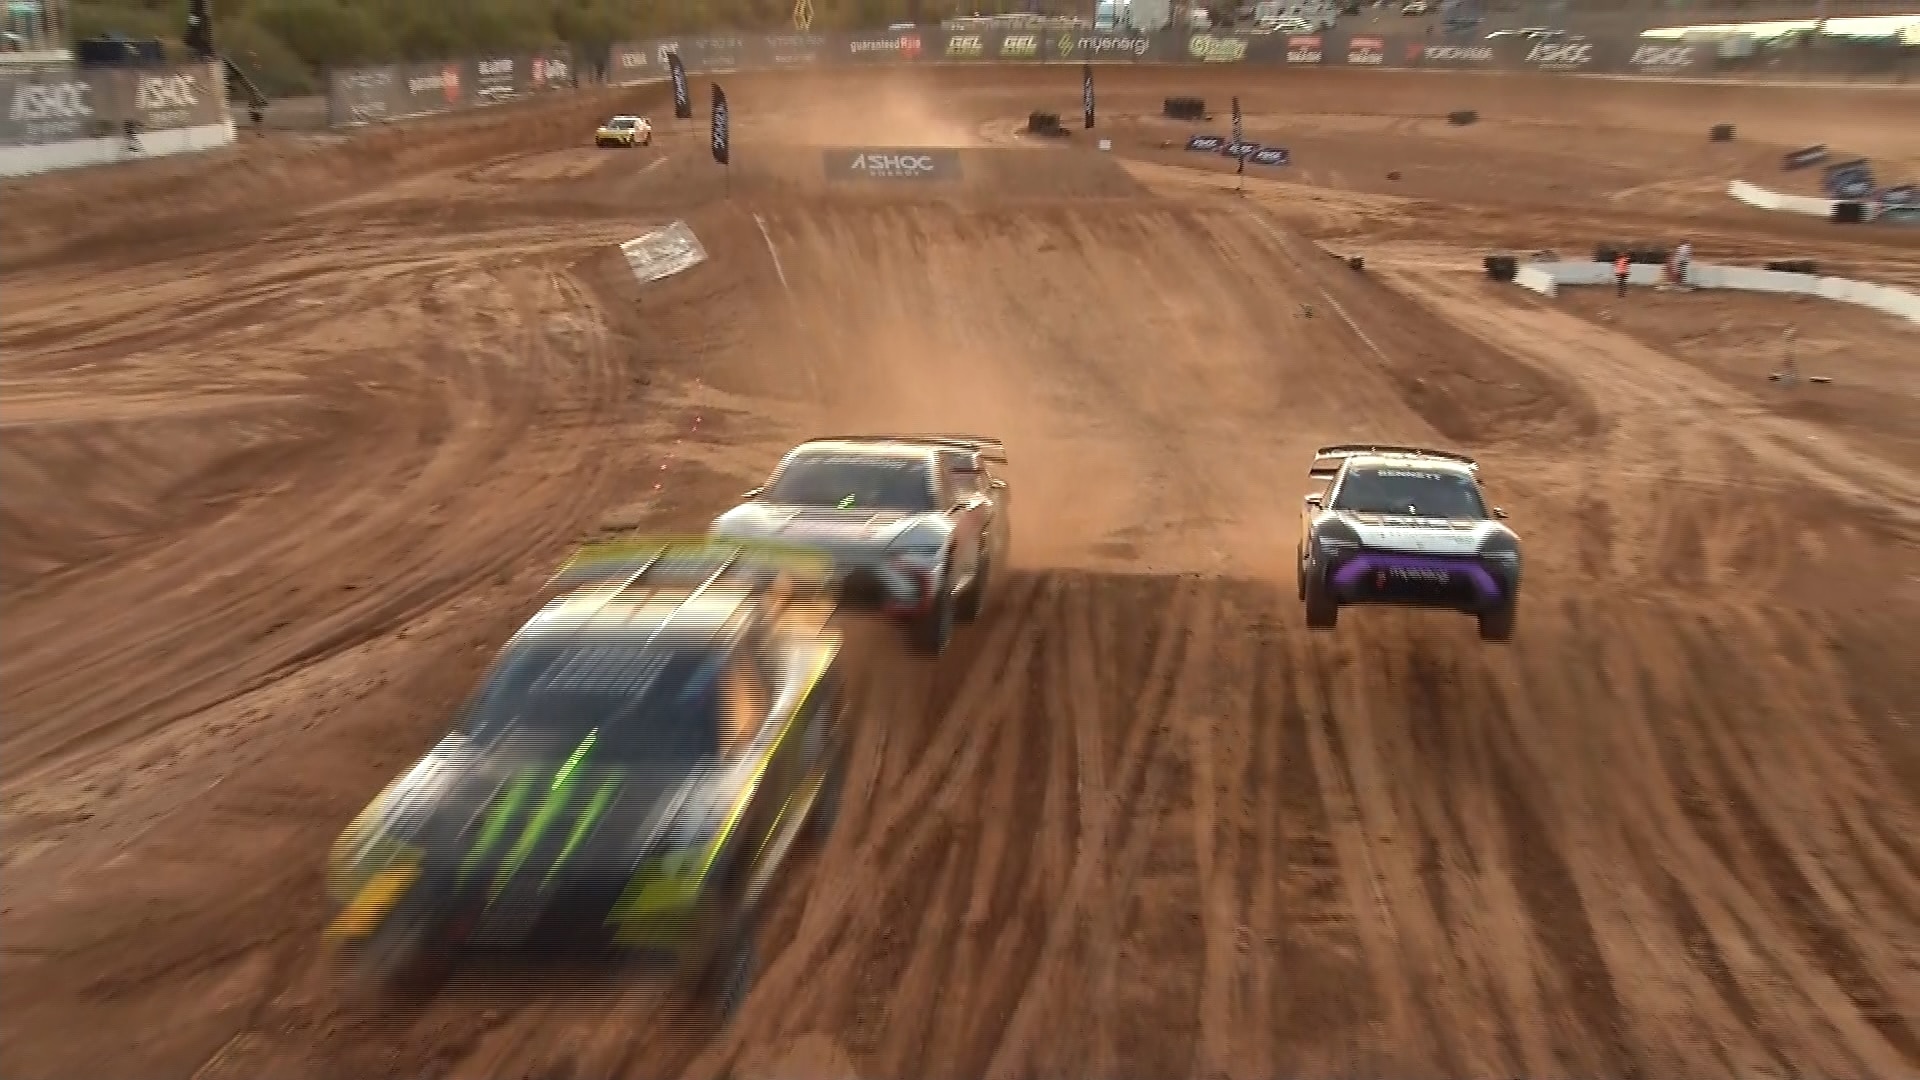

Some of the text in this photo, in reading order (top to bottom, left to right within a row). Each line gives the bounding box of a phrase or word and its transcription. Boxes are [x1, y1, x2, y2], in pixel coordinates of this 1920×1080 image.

[1077, 35, 1150, 55] myenergi
[1424, 45, 1494, 61] YOKOHAMA
[1525, 41, 1593, 64] ASHOC
[1628, 44, 1696, 66] ASHOC
[9, 81, 94, 121] ASHOC
[136, 75, 199, 109] ASHOC
[851, 153, 935, 171] ASHOC
